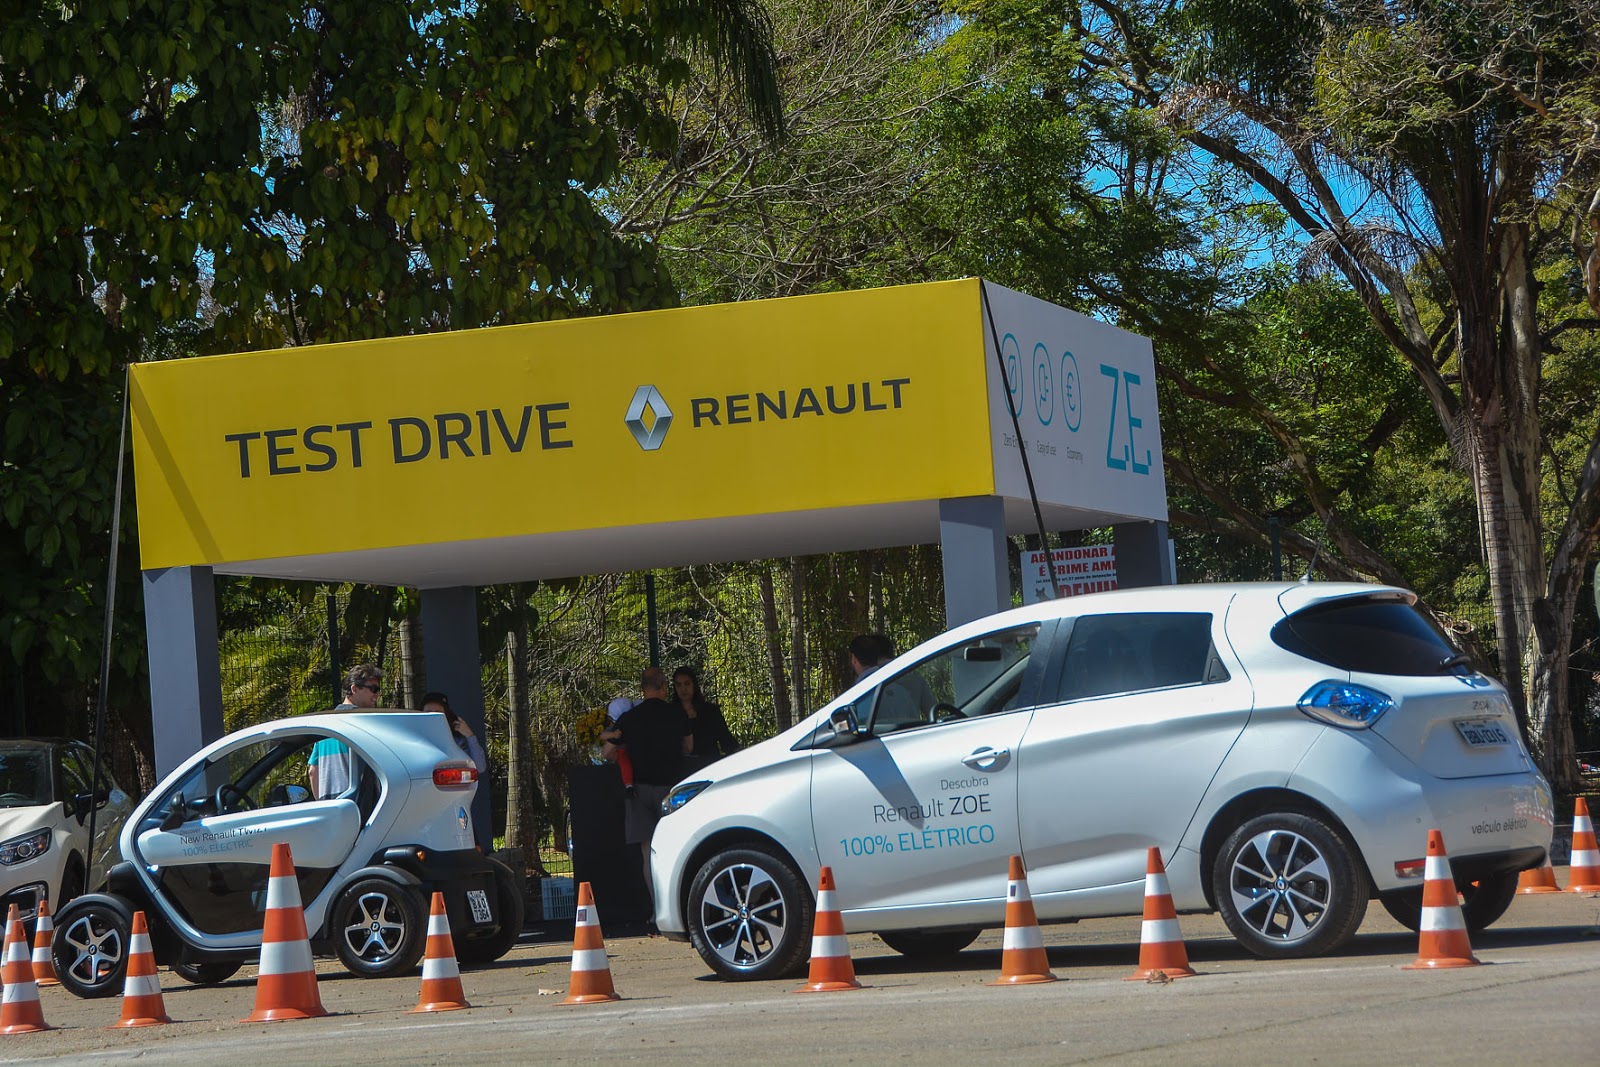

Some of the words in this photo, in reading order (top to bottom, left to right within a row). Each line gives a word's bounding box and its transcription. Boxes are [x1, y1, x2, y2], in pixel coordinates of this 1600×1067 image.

[690, 377, 911, 428] RENAULT
[1100, 363, 1152, 476] ZE
[224, 421, 373, 479] TEST
[387, 401, 574, 465] DRIVE
[1031, 547, 1107, 564] ABANDONAR
[1039, 565, 1046, 577] É
[940, 776, 989, 791] Descubra
[873, 798, 945, 824] Renault
[949, 793, 992, 816] ZOE
[1471, 819, 1502, 834] veículo
[1503, 818, 1528, 831] elétrico
[180, 835, 201, 845] New
[202, 828, 236, 842] Renault
[840, 834, 894, 857] 100%
[897, 824, 995, 852] ELÉTRICO
[183, 846, 208, 857] 100%
[209, 839, 254, 853] ELECTRIC
